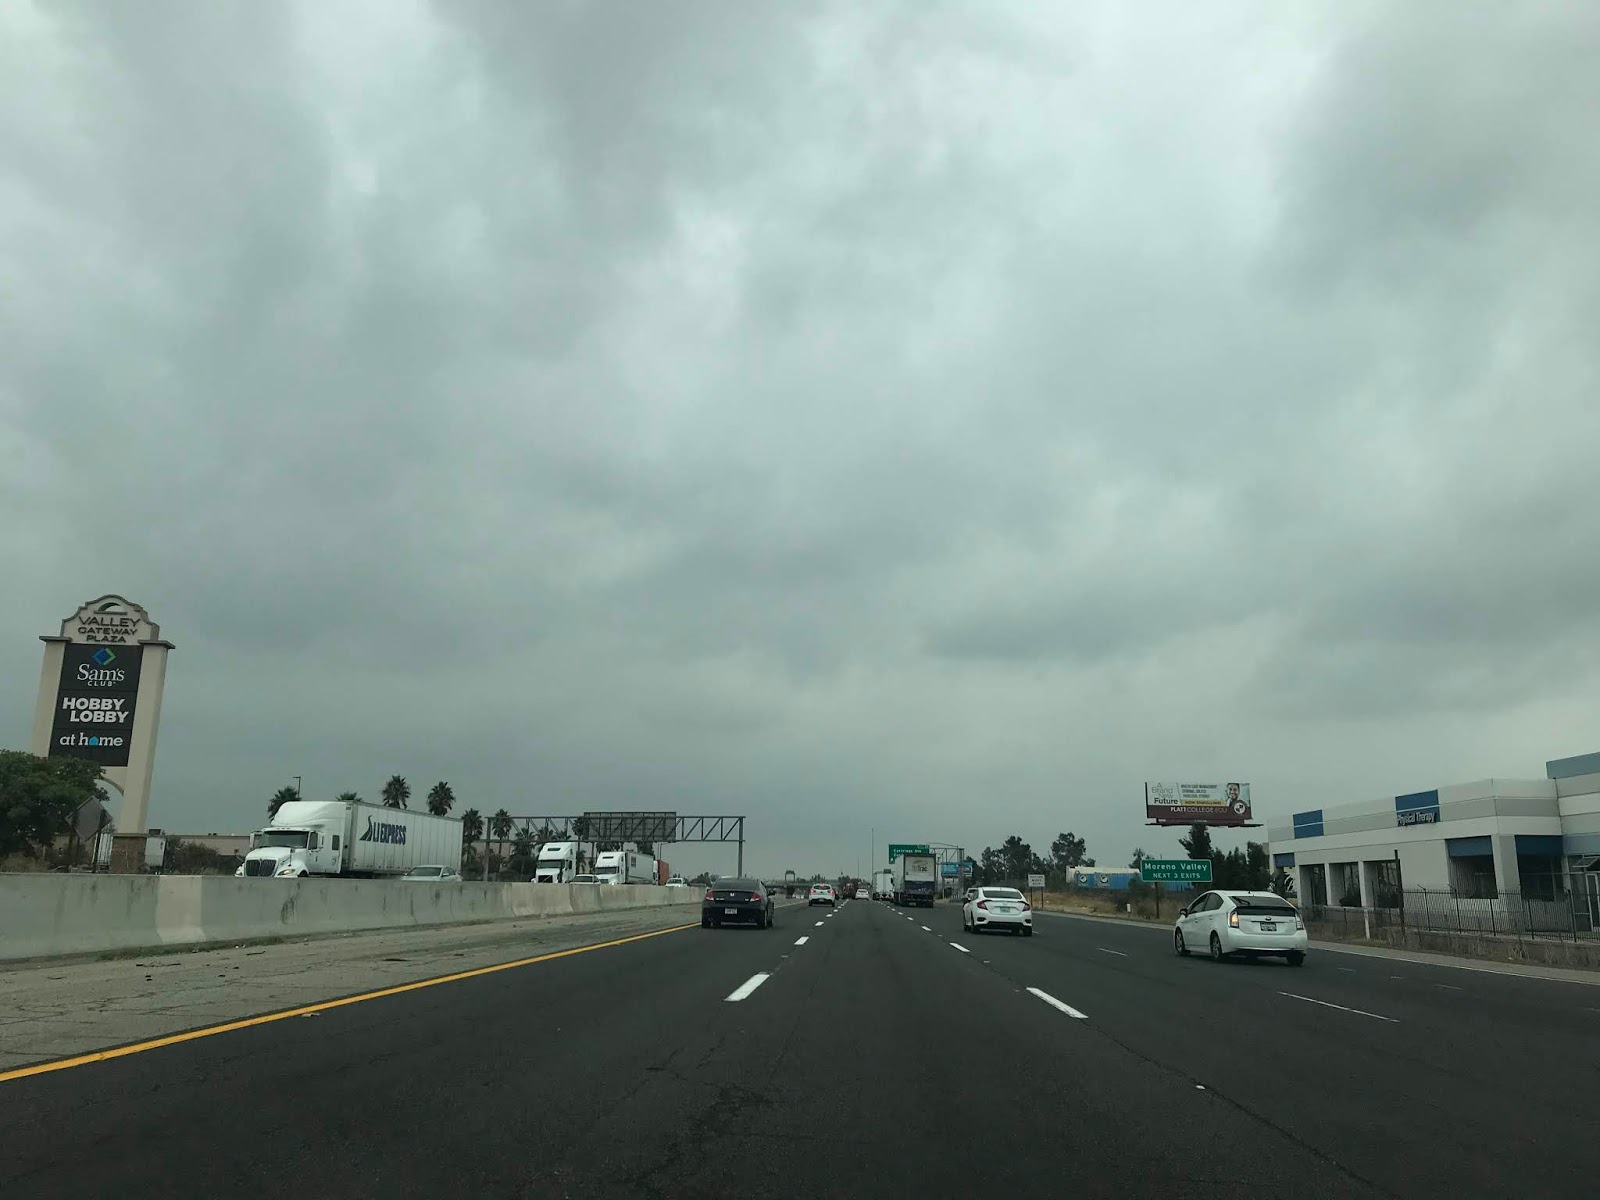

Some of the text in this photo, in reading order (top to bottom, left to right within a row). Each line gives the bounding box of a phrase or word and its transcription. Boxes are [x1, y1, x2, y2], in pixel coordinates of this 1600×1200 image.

[78, 616, 141, 627] VALLEY
[78, 627, 138, 635] GATEWAY
[86, 635, 126, 643] PLAZA
[77, 663, 125, 682] Sam's
[62, 697, 125, 710] HOBBY
[70, 711, 129, 723] LOBBY
[59, 732, 123, 747] at home
[1144, 862, 1208, 871] Moreno Valley
